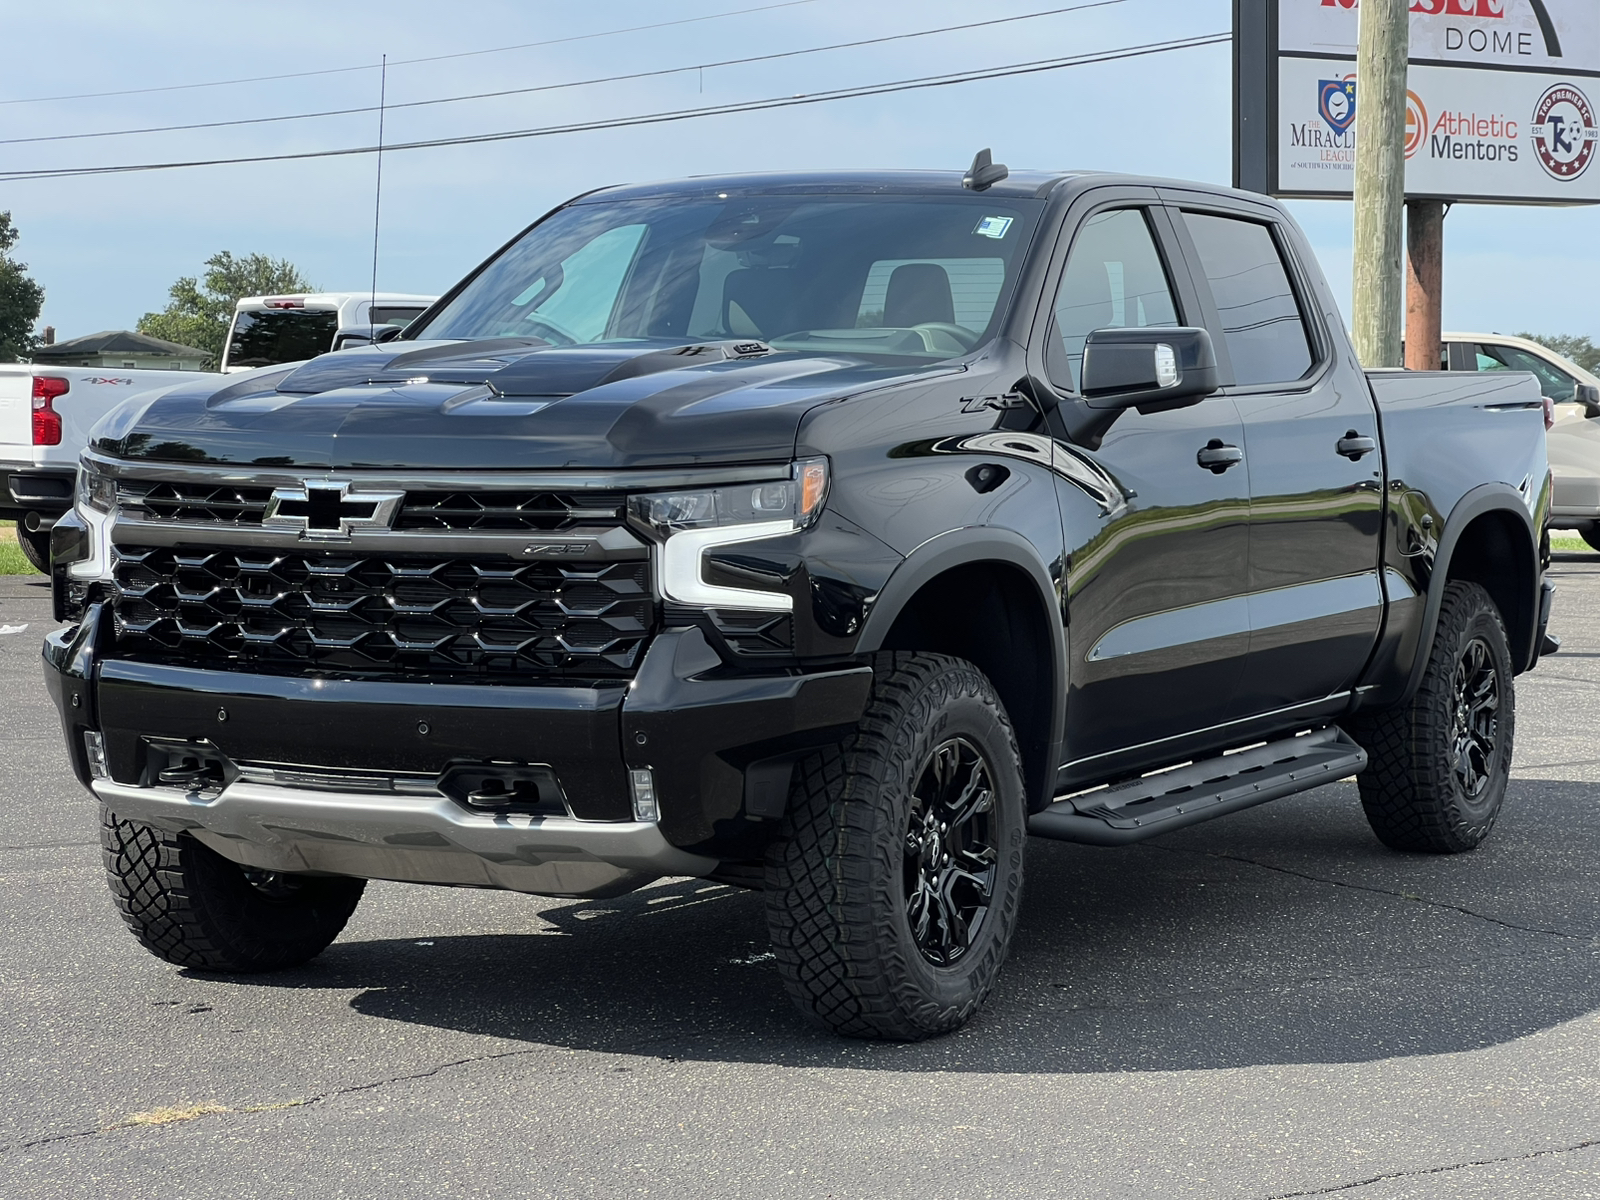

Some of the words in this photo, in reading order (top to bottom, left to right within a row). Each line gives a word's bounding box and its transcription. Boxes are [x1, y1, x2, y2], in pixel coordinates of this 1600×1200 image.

[1446, 28, 1532, 55] DOME
[1539, 98, 1552, 117] TKO
[1551, 90, 1583, 108] PREMIER
[1581, 106, 1590, 120] SC
[1308, 120, 1320, 128] THE
[1431, 110, 1518, 139] Athletic
[1531, 126, 1544, 135] EST.
[1584, 130, 1598, 138] 1983
[1431, 134, 1519, 162] Mentors
[1290, 161, 1297, 169] of
[1297, 162, 1331, 170] SOUTHWEST
[959, 392, 1024, 414] ZR2
